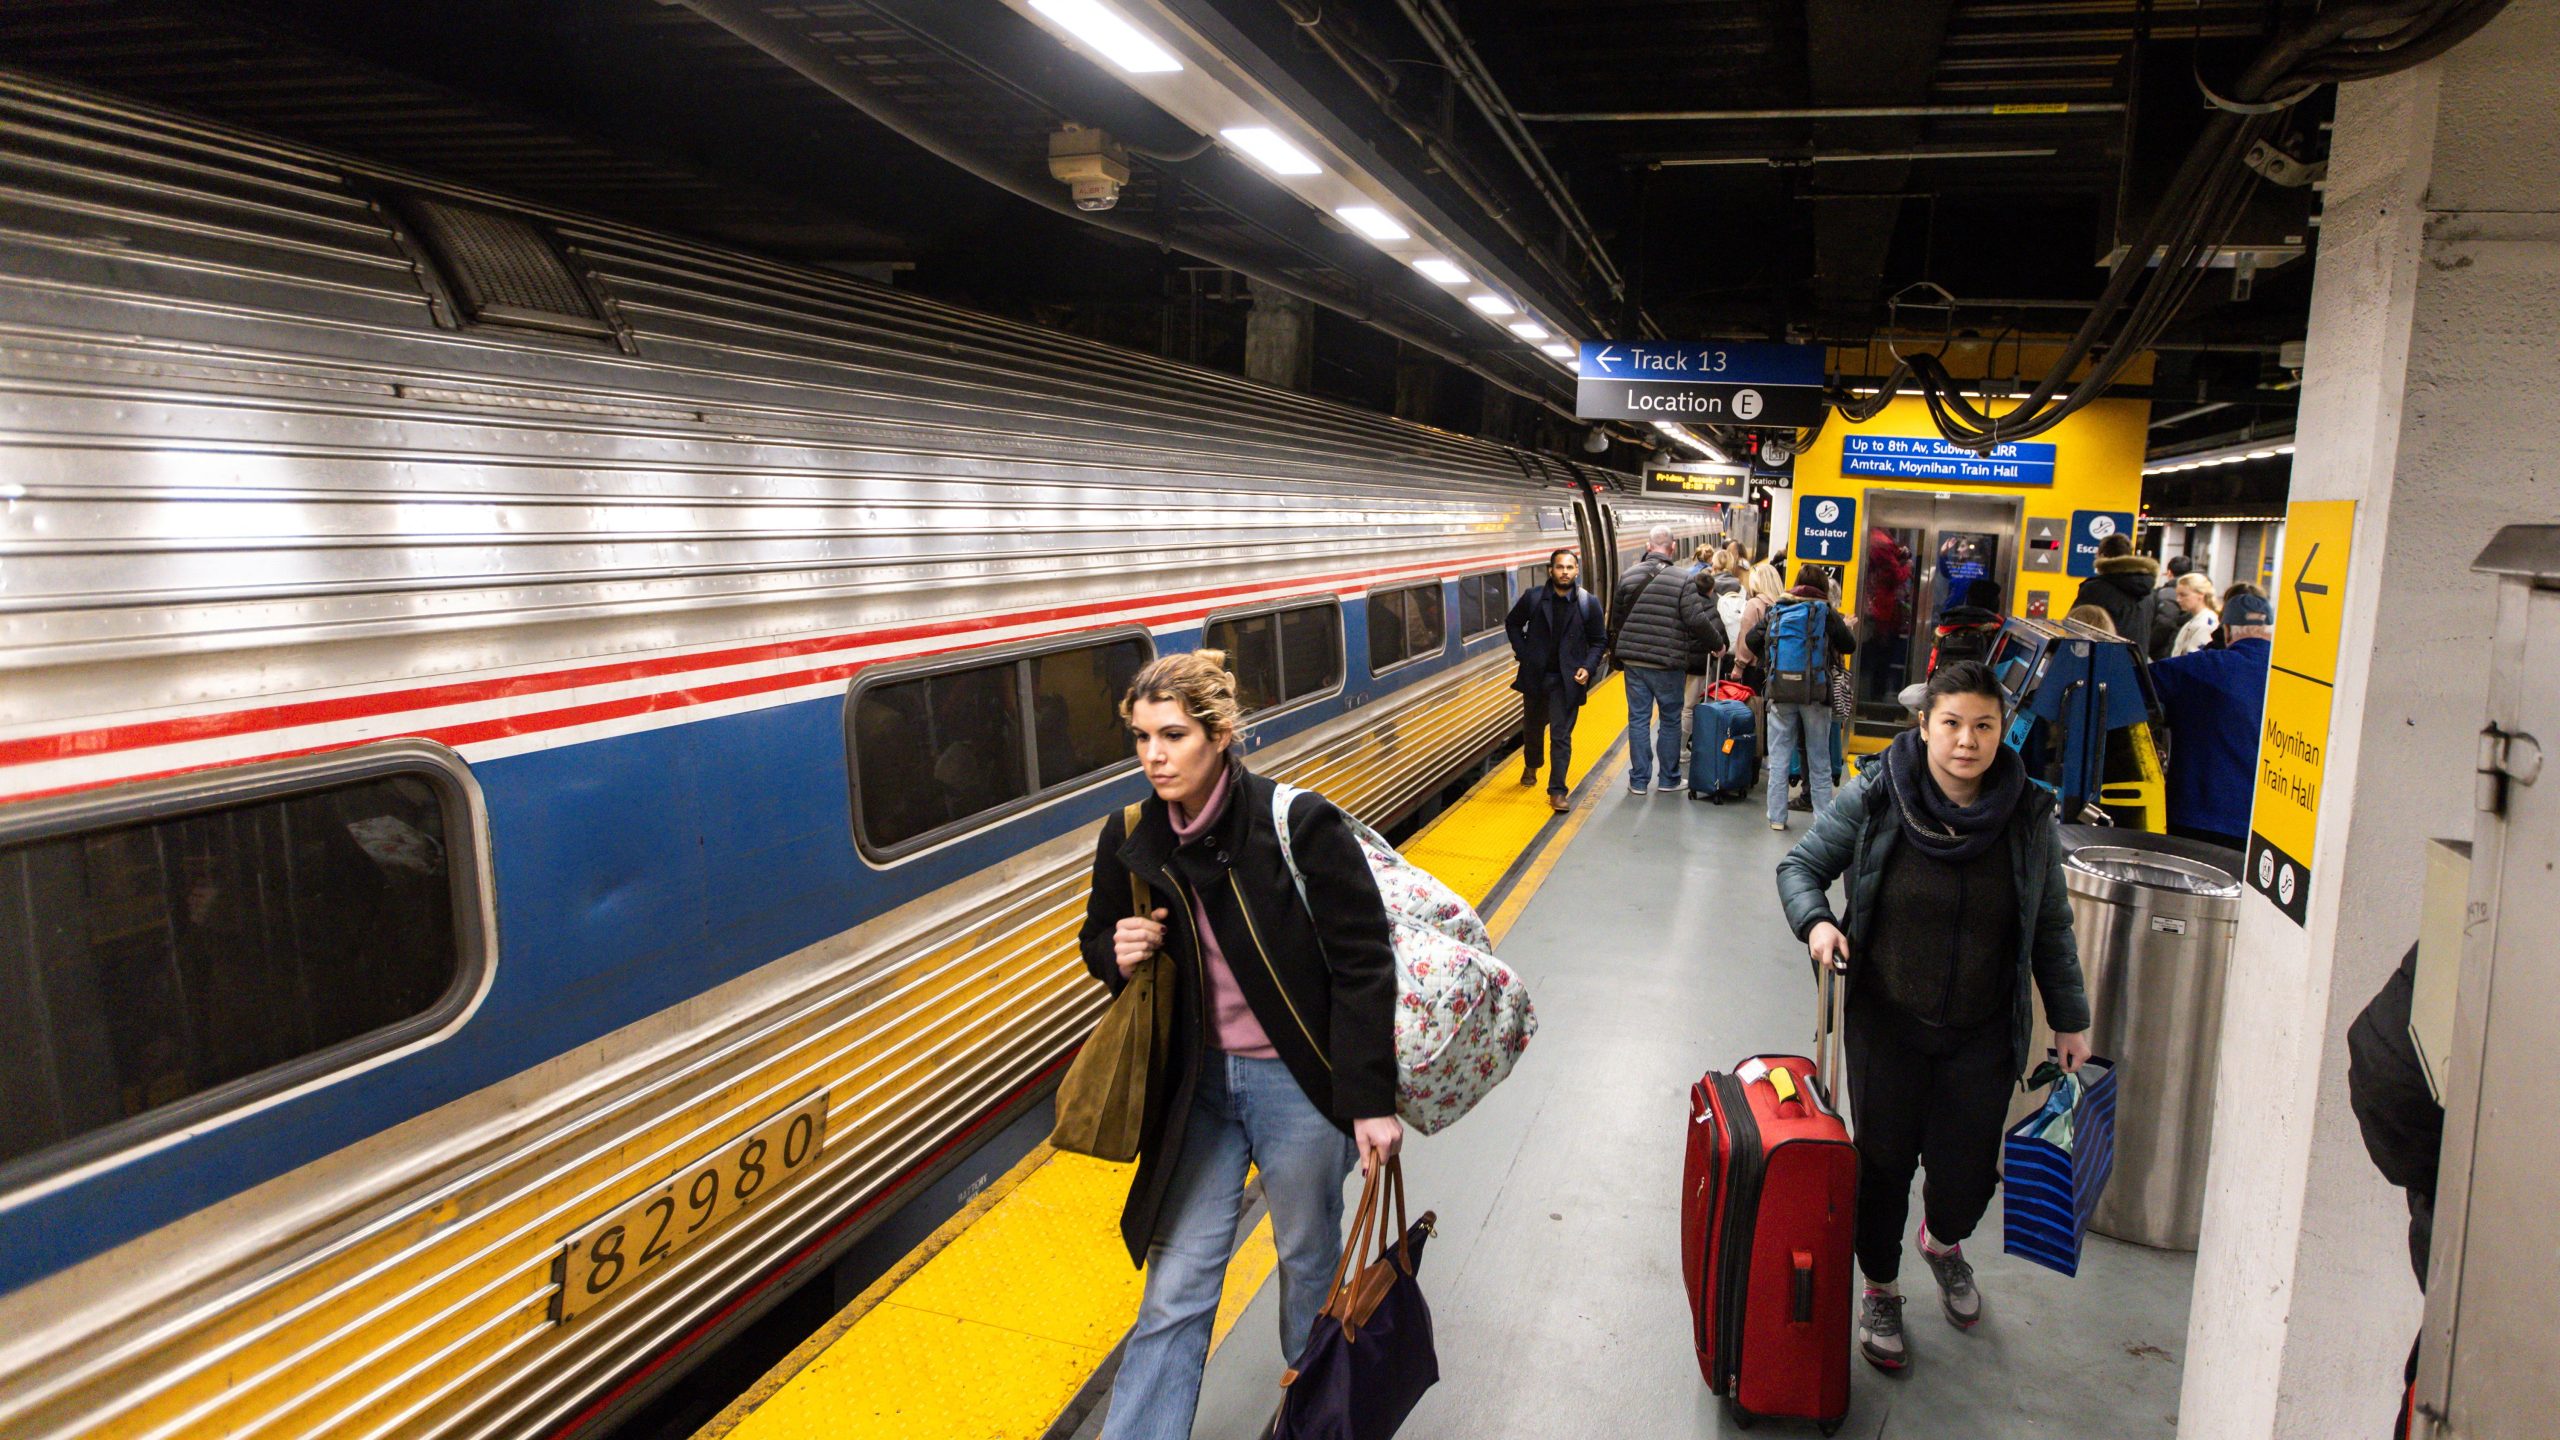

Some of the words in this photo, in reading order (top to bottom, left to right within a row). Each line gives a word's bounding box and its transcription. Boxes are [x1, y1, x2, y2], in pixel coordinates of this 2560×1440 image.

[1631, 349, 1688, 371] Track
[1698, 351, 1727, 372] 13
[1627, 389, 1721, 413] Location
[1852, 438, 1868, 453] Up
[1872, 440, 1884, 451] to
[1888, 440, 1908, 452] 8th
[1912, 441, 1929, 455] Av,
[1850, 458, 1895, 473] Amtrak,
[1898, 460, 1956, 476] Moynihan
[1960, 462, 1990, 476] Train
[1993, 464, 2018, 477] Hall
[1804, 527, 1847, 538] Escalator
[2266, 718, 2319, 767] Moynihan
[2263, 758, 2288, 796] Train
[2290, 774, 2314, 812] Hall
[586, 1113, 813, 1295] 82980
